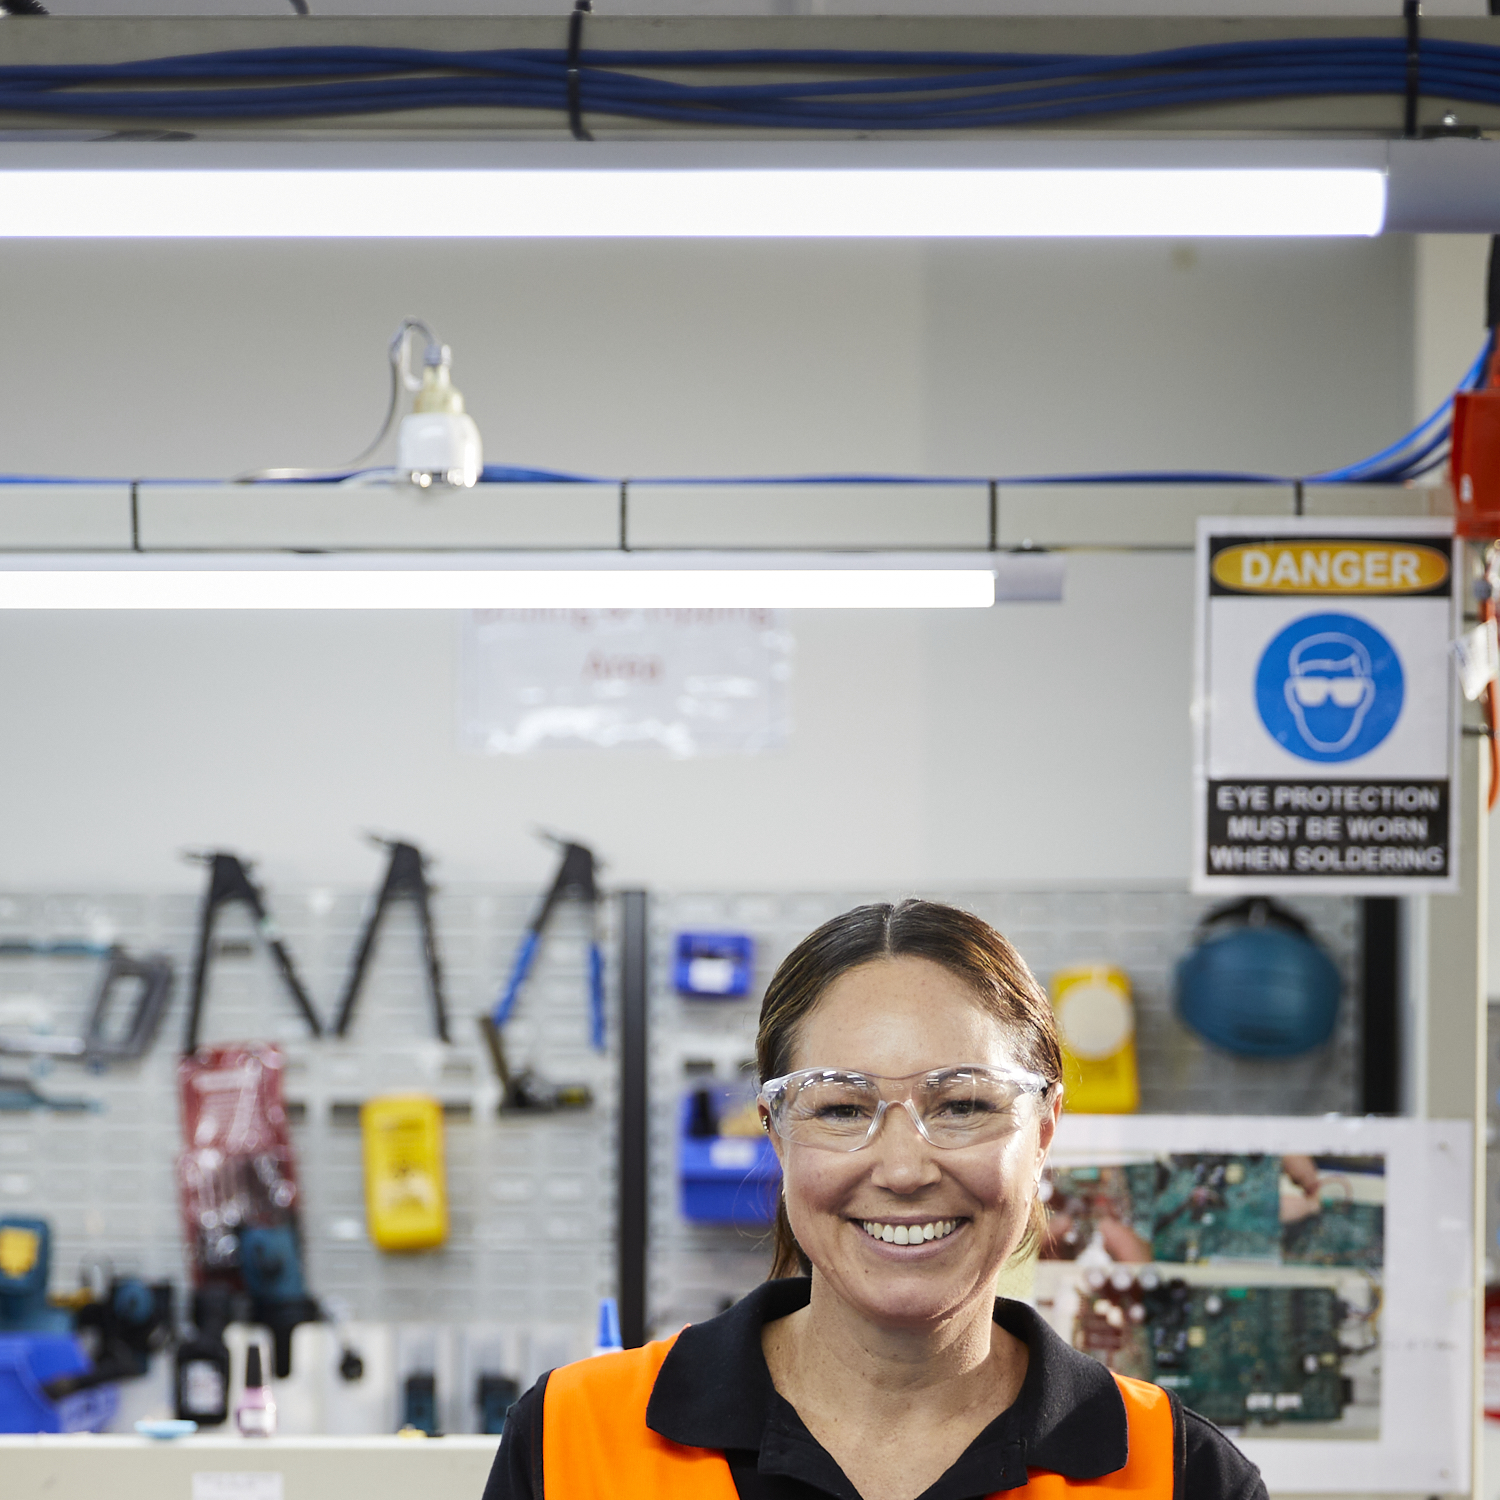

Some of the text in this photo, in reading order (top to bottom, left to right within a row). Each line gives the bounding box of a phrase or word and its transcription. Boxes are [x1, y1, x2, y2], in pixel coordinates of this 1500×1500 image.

[1242, 550, 1421, 586] DANGER
[1217, 786, 1439, 811] EYE PROTECTION
[1228, 816, 1428, 840] MUST BE WORN
[1211, 846, 1444, 871] WHEN SOLDERING
